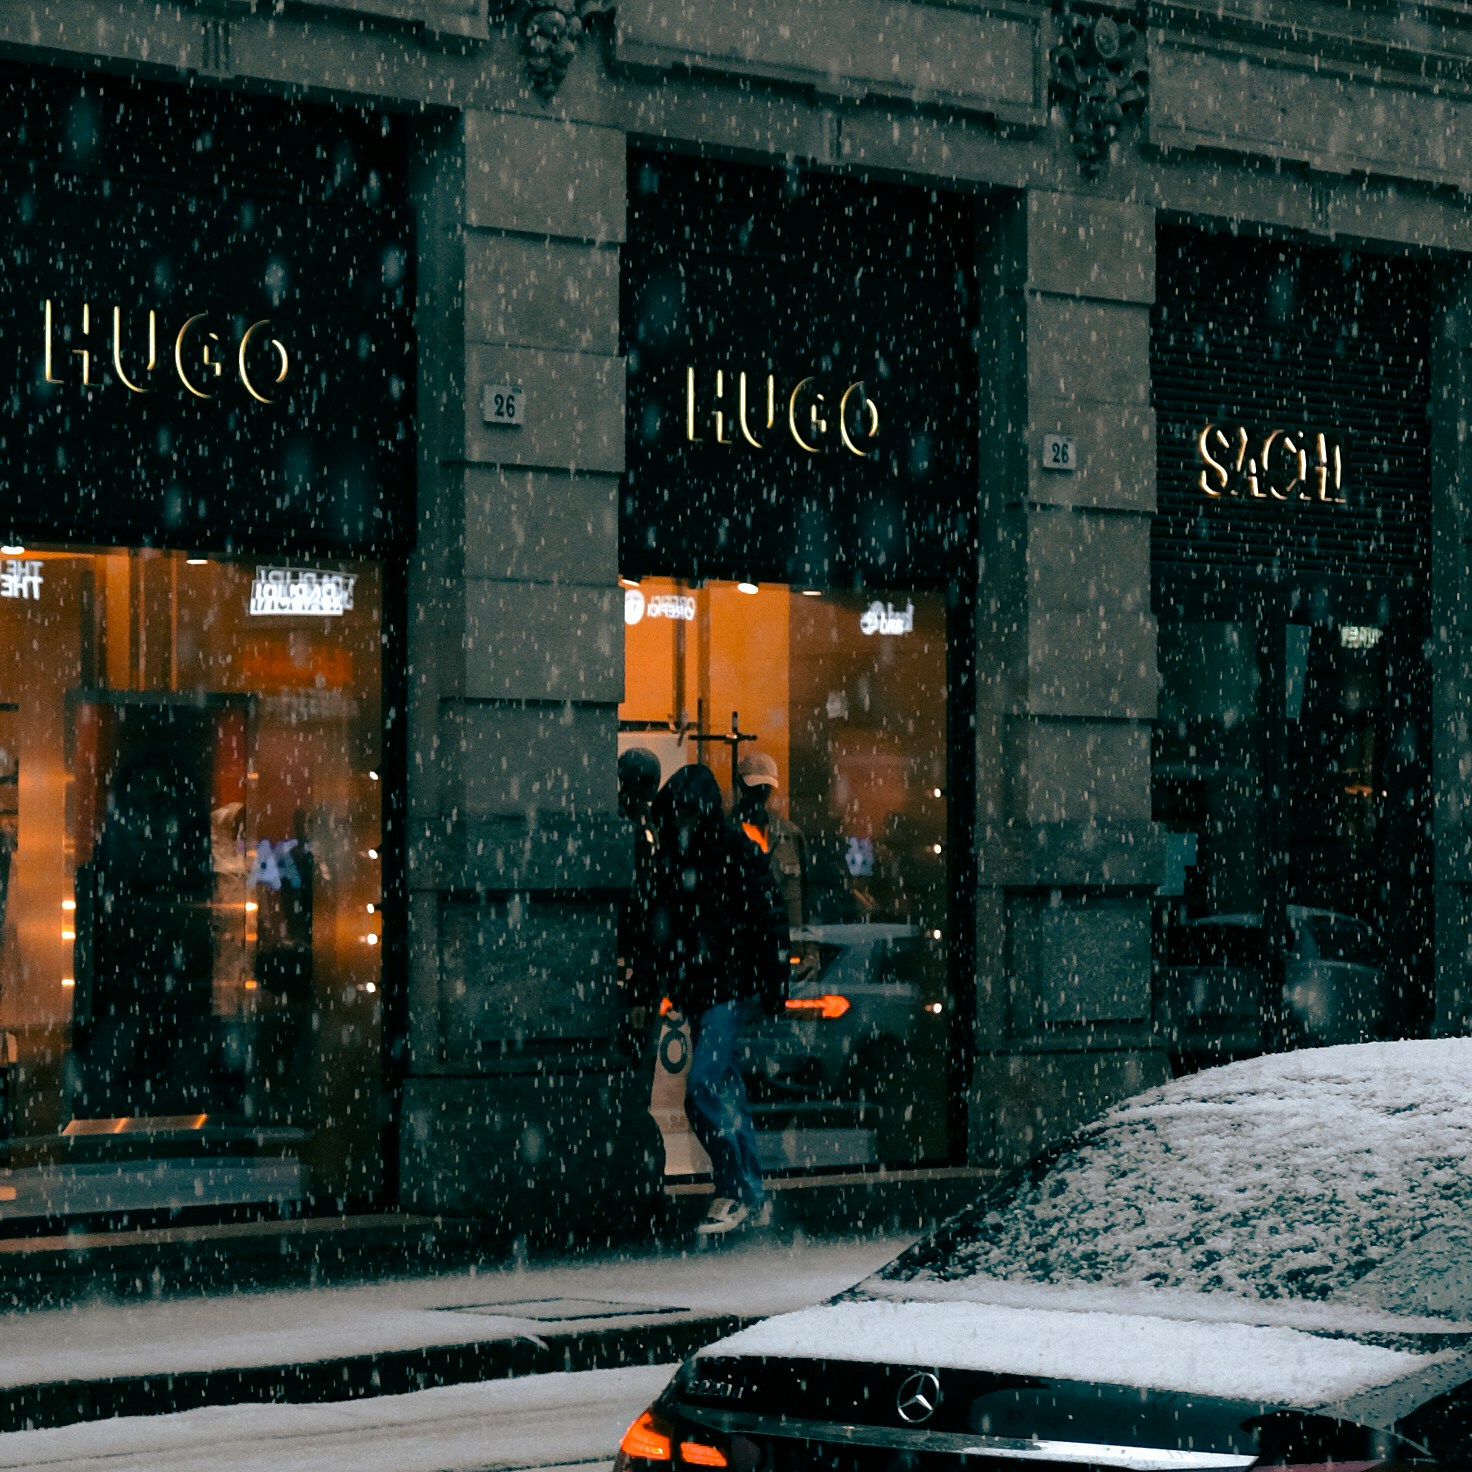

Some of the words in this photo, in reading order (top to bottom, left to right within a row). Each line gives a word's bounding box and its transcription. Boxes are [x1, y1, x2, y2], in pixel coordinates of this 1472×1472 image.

[44, 298, 289, 405] HUGO
[494, 393, 516, 418] 26
[686, 365, 880, 458] HUGO
[1051, 441, 1070, 464] 26
